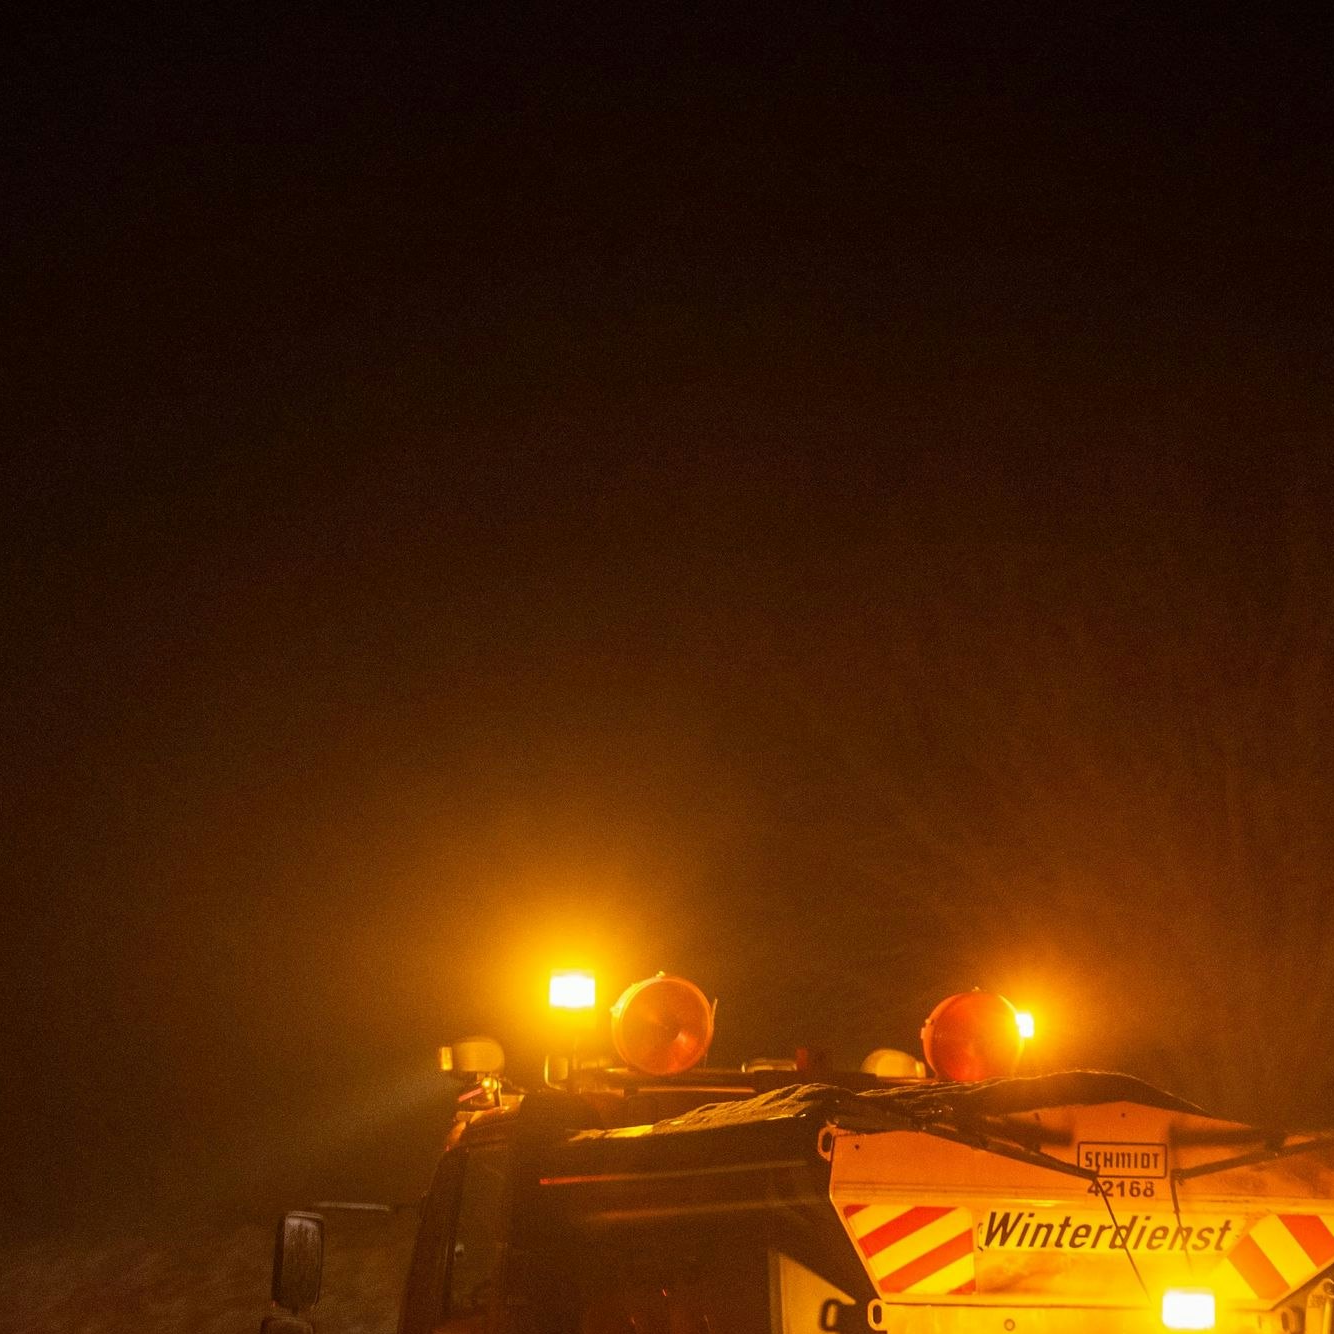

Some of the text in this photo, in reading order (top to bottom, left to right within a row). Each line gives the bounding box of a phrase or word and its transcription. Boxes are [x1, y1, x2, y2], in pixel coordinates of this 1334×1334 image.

[1084, 1151, 1160, 1168] SCHMIDT
[1087, 1180, 1155, 1197] 42168
[984, 1211, 1233, 1251] Winterdienst
